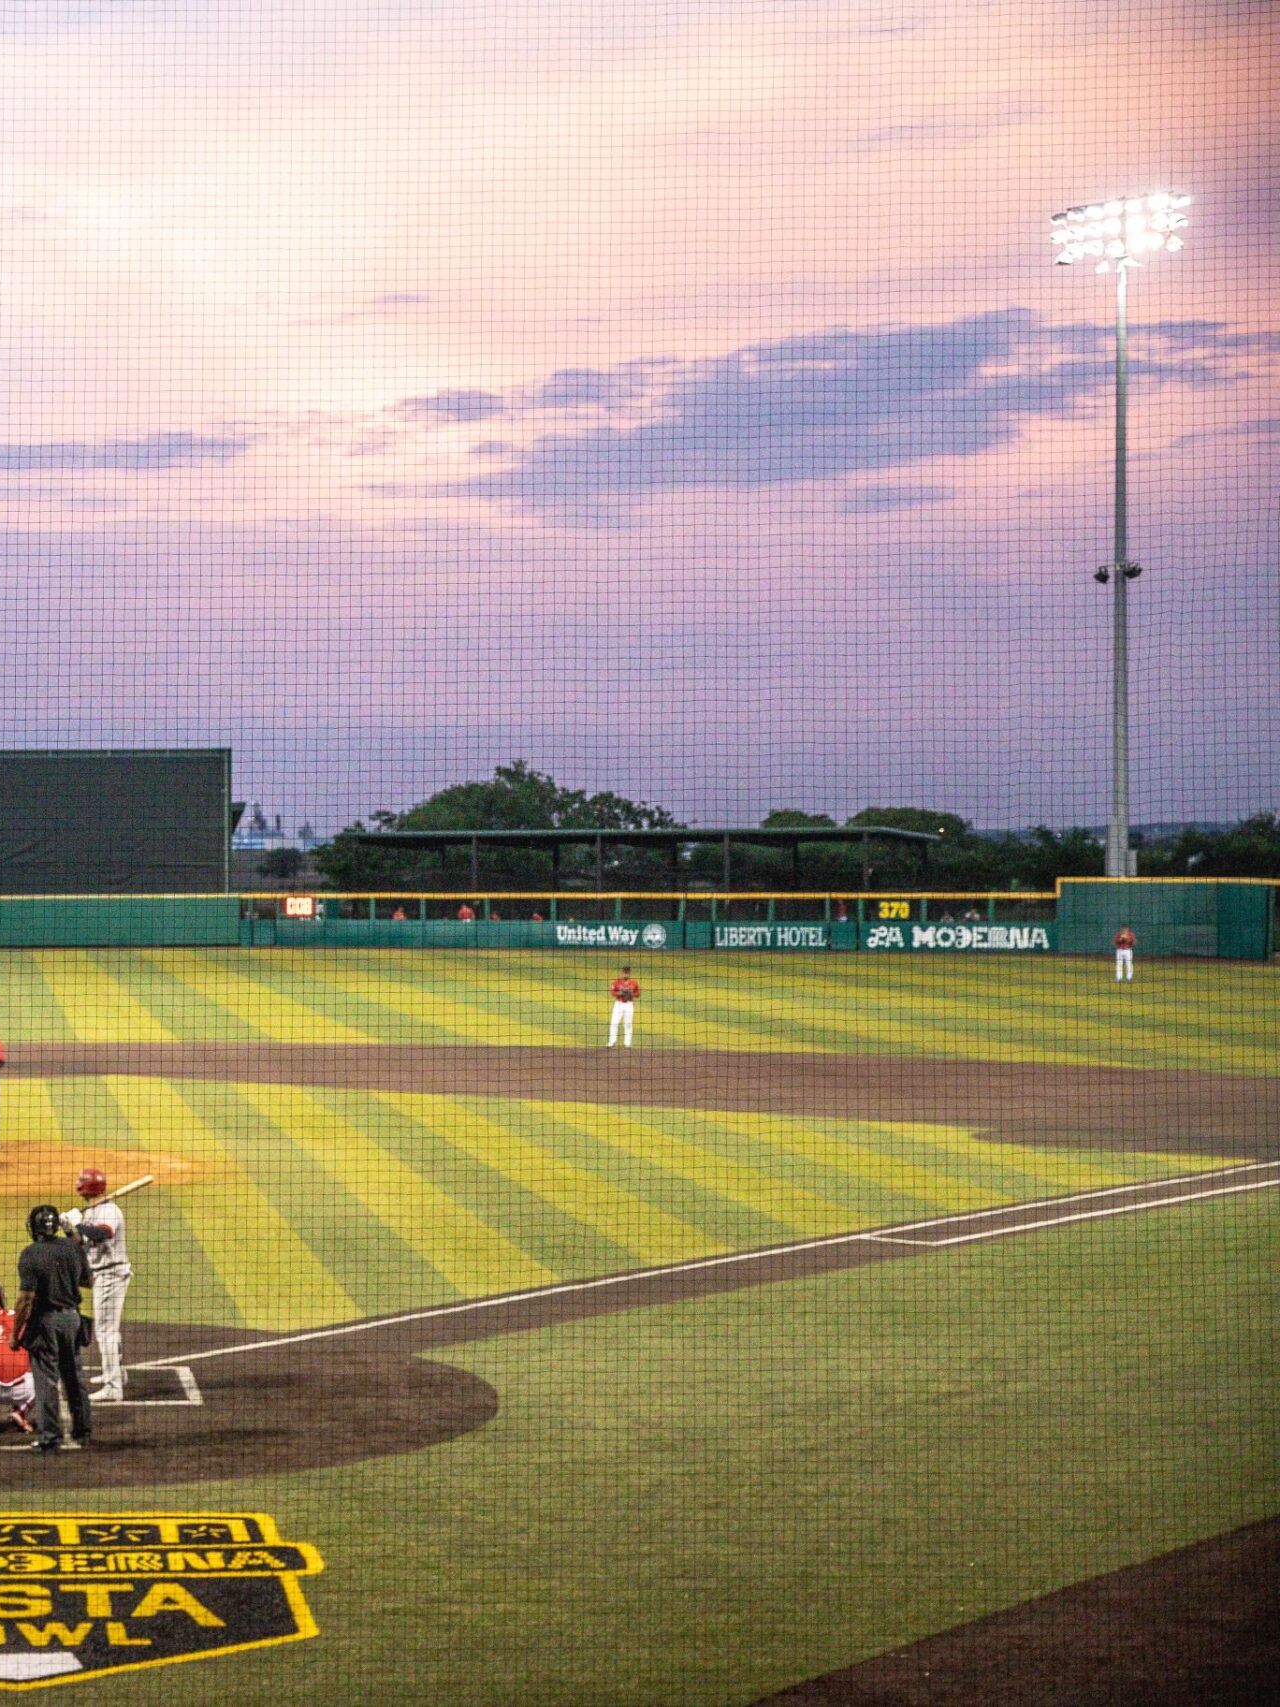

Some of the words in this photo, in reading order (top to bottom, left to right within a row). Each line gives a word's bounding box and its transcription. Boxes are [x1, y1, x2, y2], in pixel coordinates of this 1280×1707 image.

[878, 901, 910, 919] 370
[556, 925, 606, 941] United
[607, 925, 639, 945] Way
[715, 926, 774, 947] LIBERTY
[776, 926, 827, 947] HOTEL
[866, 926, 905, 948] LA
[911, 925, 1050, 949] MODERNA
